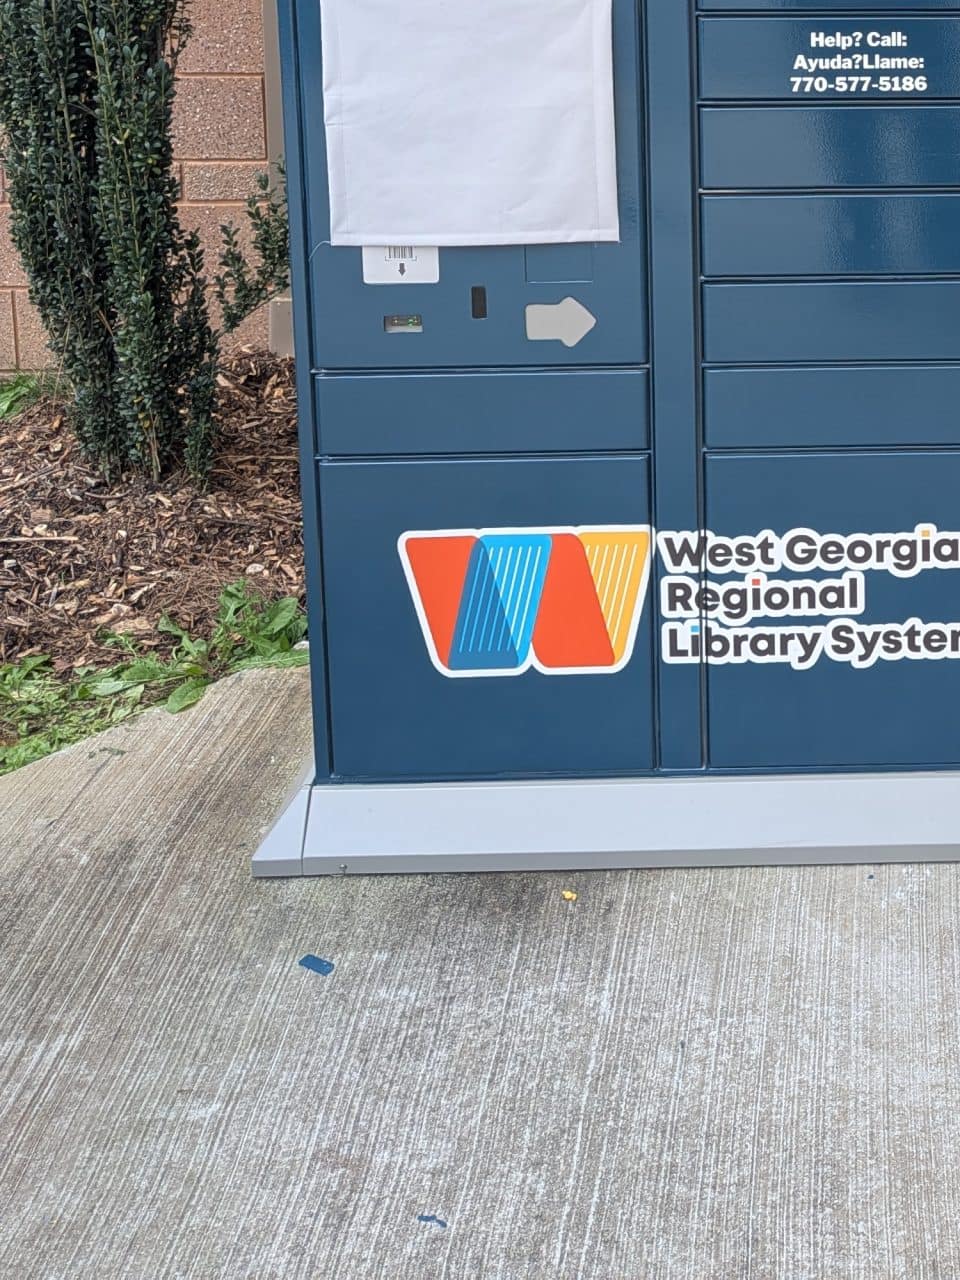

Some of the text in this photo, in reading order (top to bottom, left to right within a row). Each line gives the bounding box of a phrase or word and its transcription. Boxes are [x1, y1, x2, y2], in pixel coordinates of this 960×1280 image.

[810, 31, 908, 51] Help? Call:
[789, 75, 928, 93] 770-577-5186
[664, 530, 959, 570] West Georgia
[668, 578, 857, 619] Regional
[669, 625, 821, 663] Library
